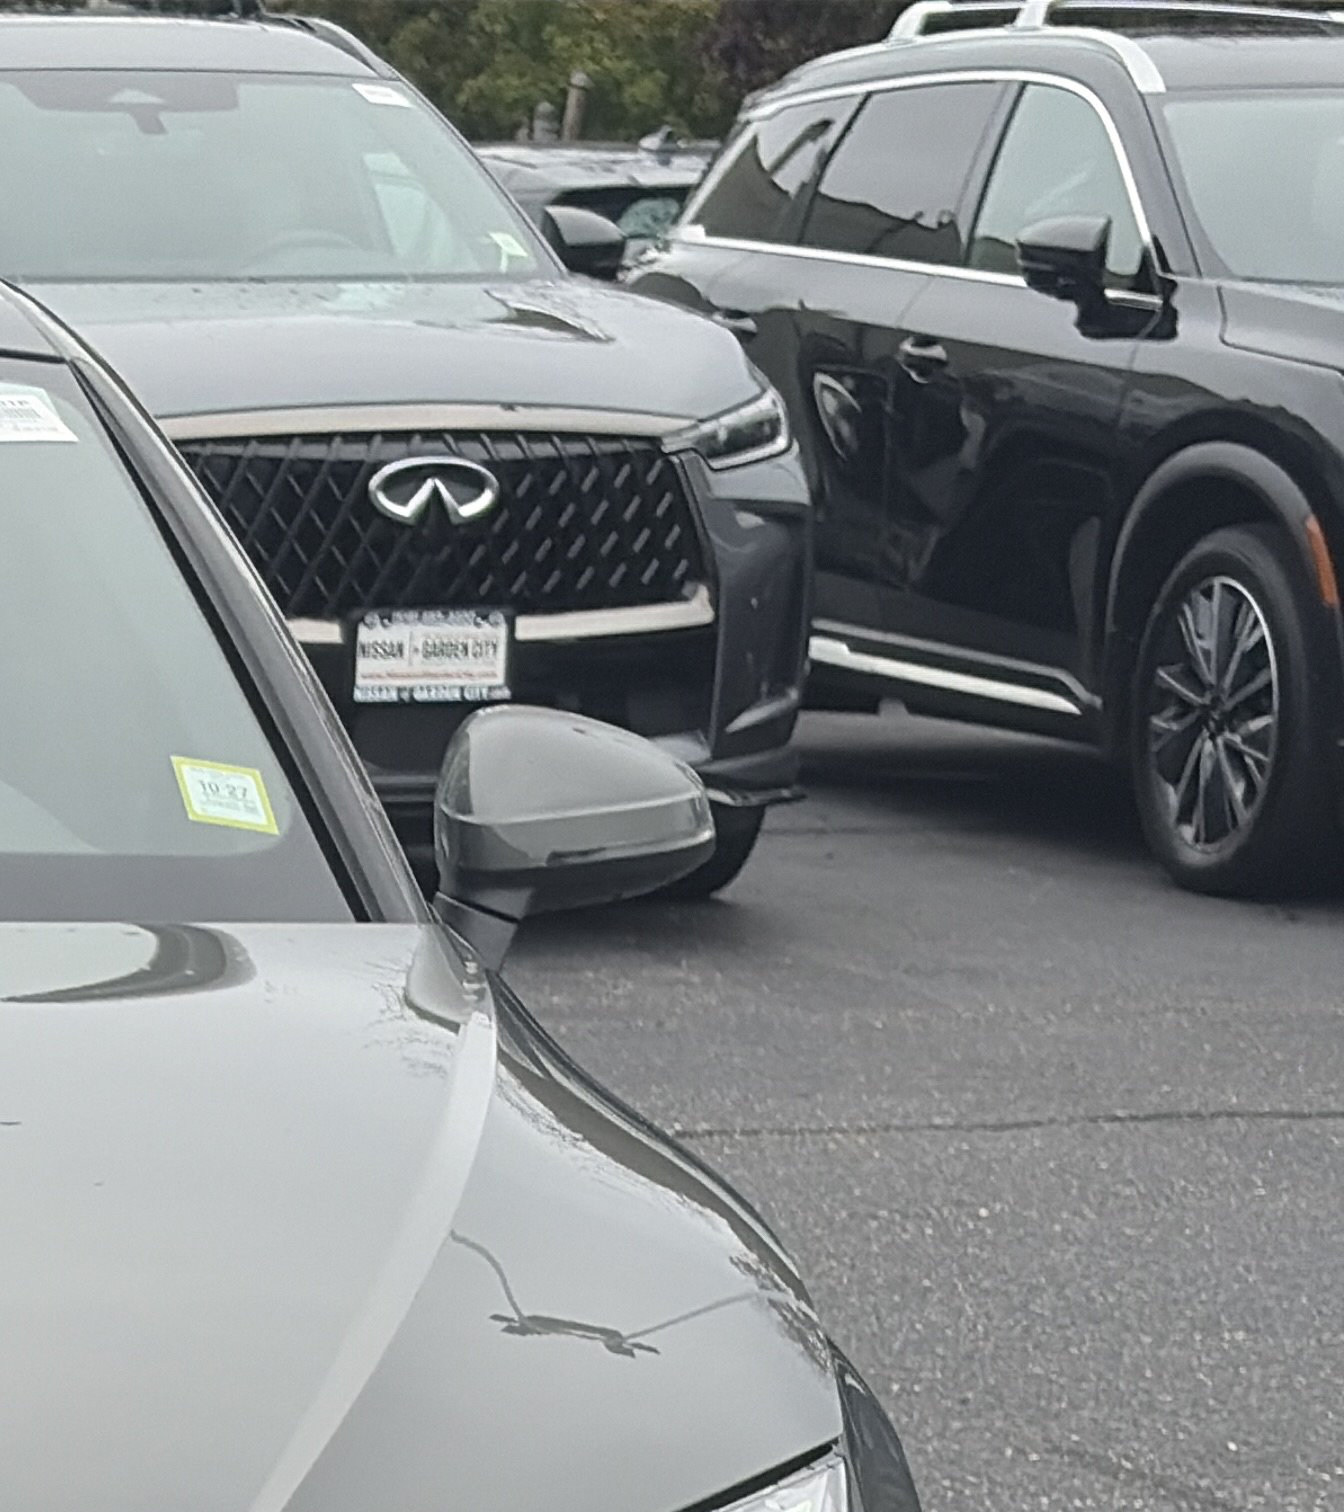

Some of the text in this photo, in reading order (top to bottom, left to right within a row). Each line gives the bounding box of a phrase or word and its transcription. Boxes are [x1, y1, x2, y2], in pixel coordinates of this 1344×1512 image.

[358, 638, 498, 660] NISSAN GARDEN CITY
